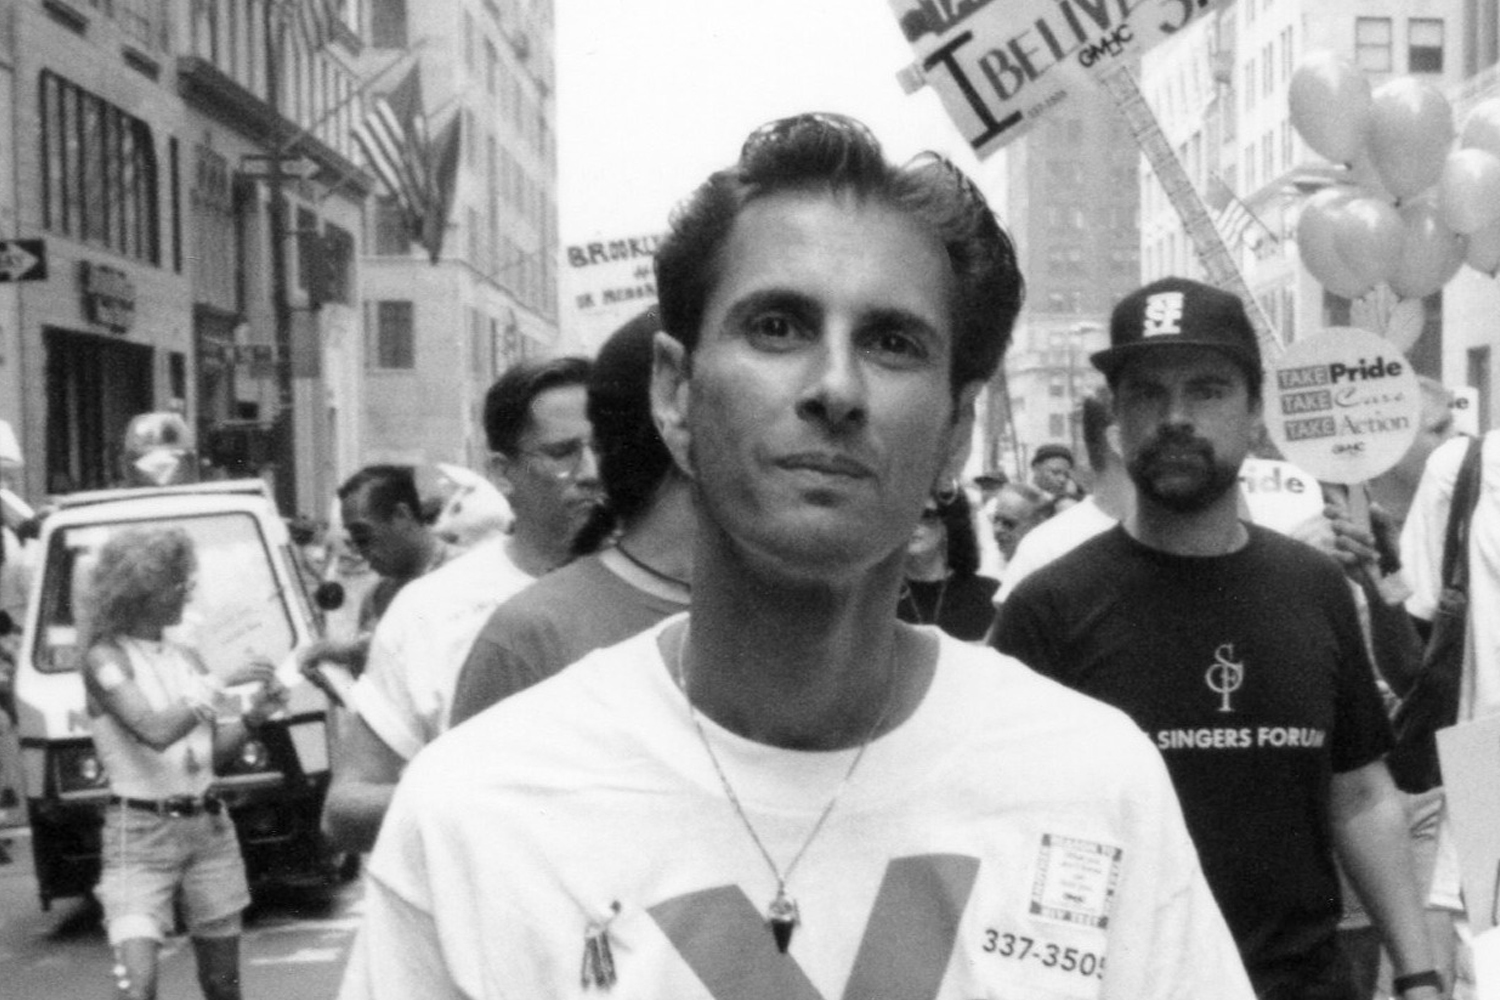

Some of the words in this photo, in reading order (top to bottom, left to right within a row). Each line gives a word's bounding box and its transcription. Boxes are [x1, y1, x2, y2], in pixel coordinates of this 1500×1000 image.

[1077, 23, 1134, 68] GMHC
[923, 30, 1023, 149] I
[1281, 368, 1328, 388] TAKE
[1329, 356, 1403, 384] Pride
[1285, 392, 1331, 413] TAKE
[1288, 418, 1336, 440] TAKE
[1157, 728, 1253, 749] SINGERS
